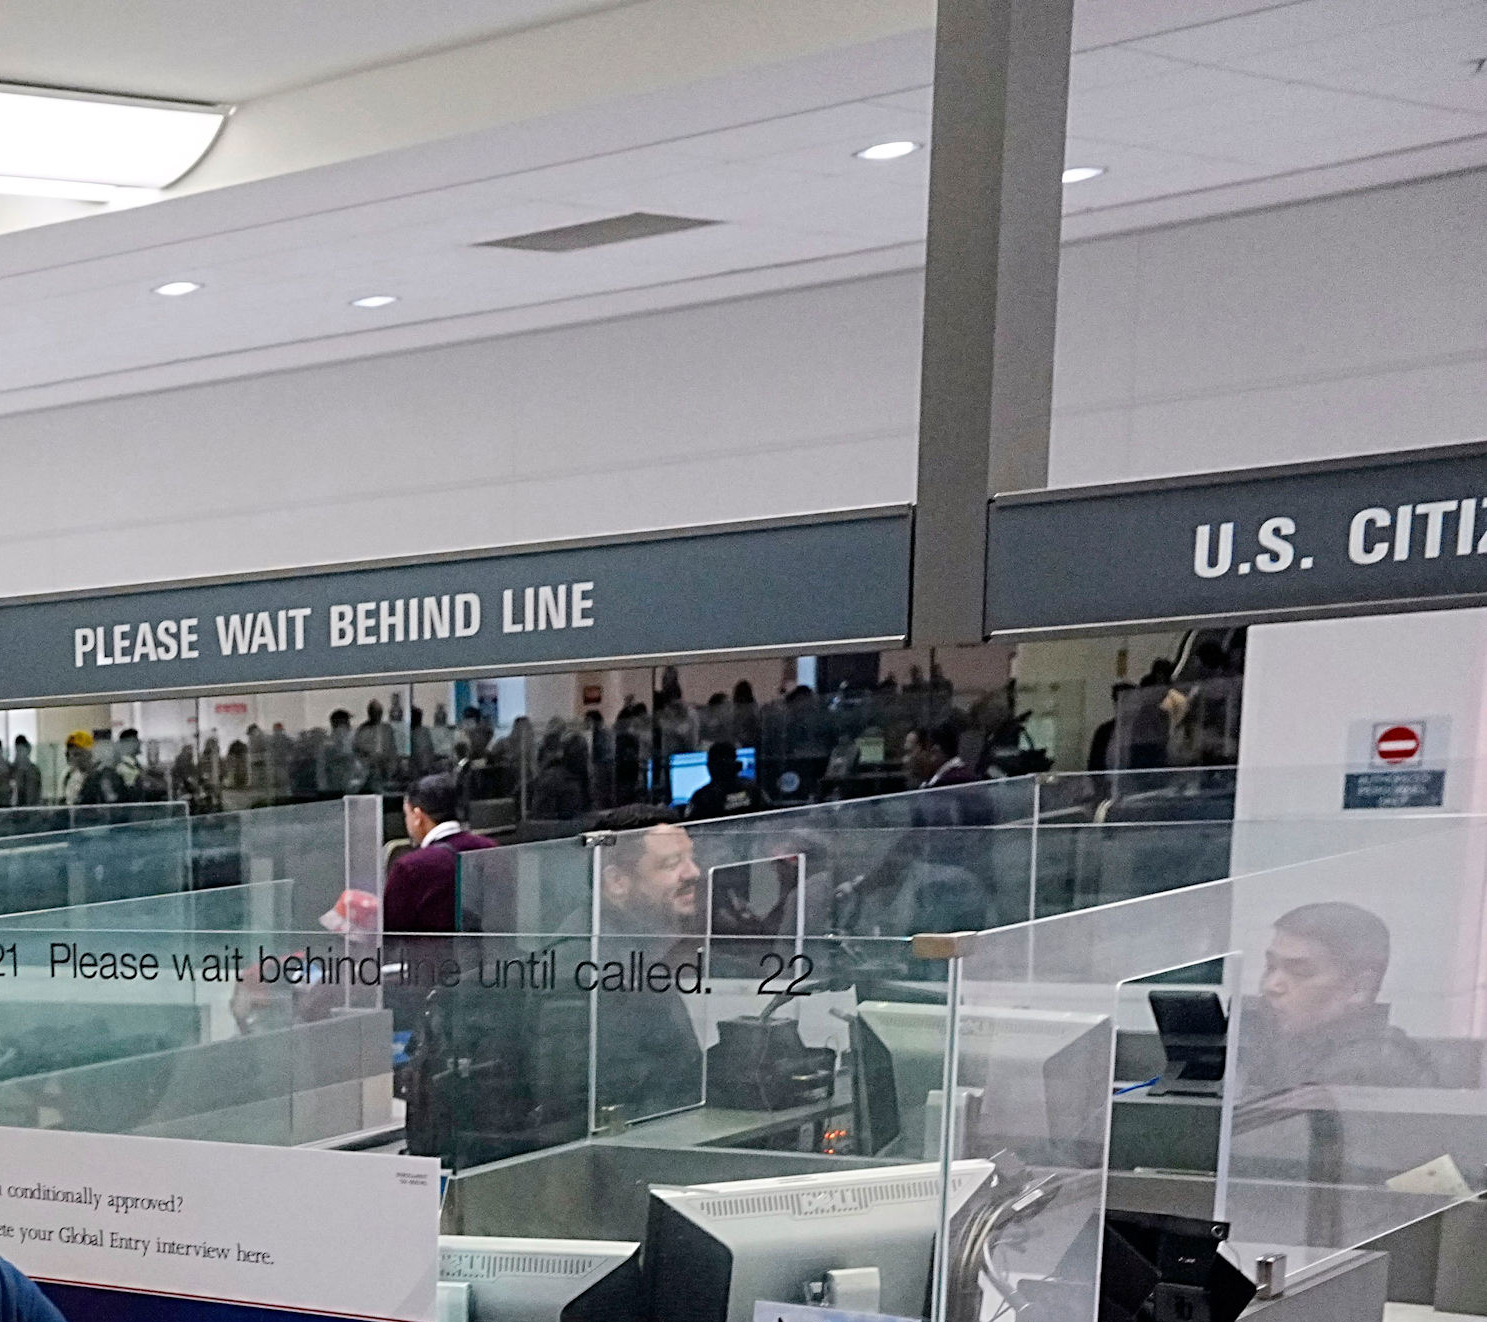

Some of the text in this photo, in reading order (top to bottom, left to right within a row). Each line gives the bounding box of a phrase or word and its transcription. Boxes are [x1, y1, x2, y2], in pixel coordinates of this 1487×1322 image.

[1194, 496, 1487, 579] U.S. CITI
[73, 580, 595, 669] PLEASE WAIT BEHIND LINE
[49, 942, 159, 981] Please
[173, 944, 245, 983] wait
[258, 945, 383, 987] behind
[476, 950, 557, 991] until
[574, 950, 713, 994] called.
[756, 952, 815, 997] 22
[7, 1182, 103, 1210] conditionally
[107, 1192, 184, 1214] approved?
[19, 1225, 55, 1244] your
[58, 1226, 105, 1249] Global
[109, 1233, 152, 1257] Entry
[155, 1238, 232, 1261] interview
[236, 1245, 275, 1267] here.
